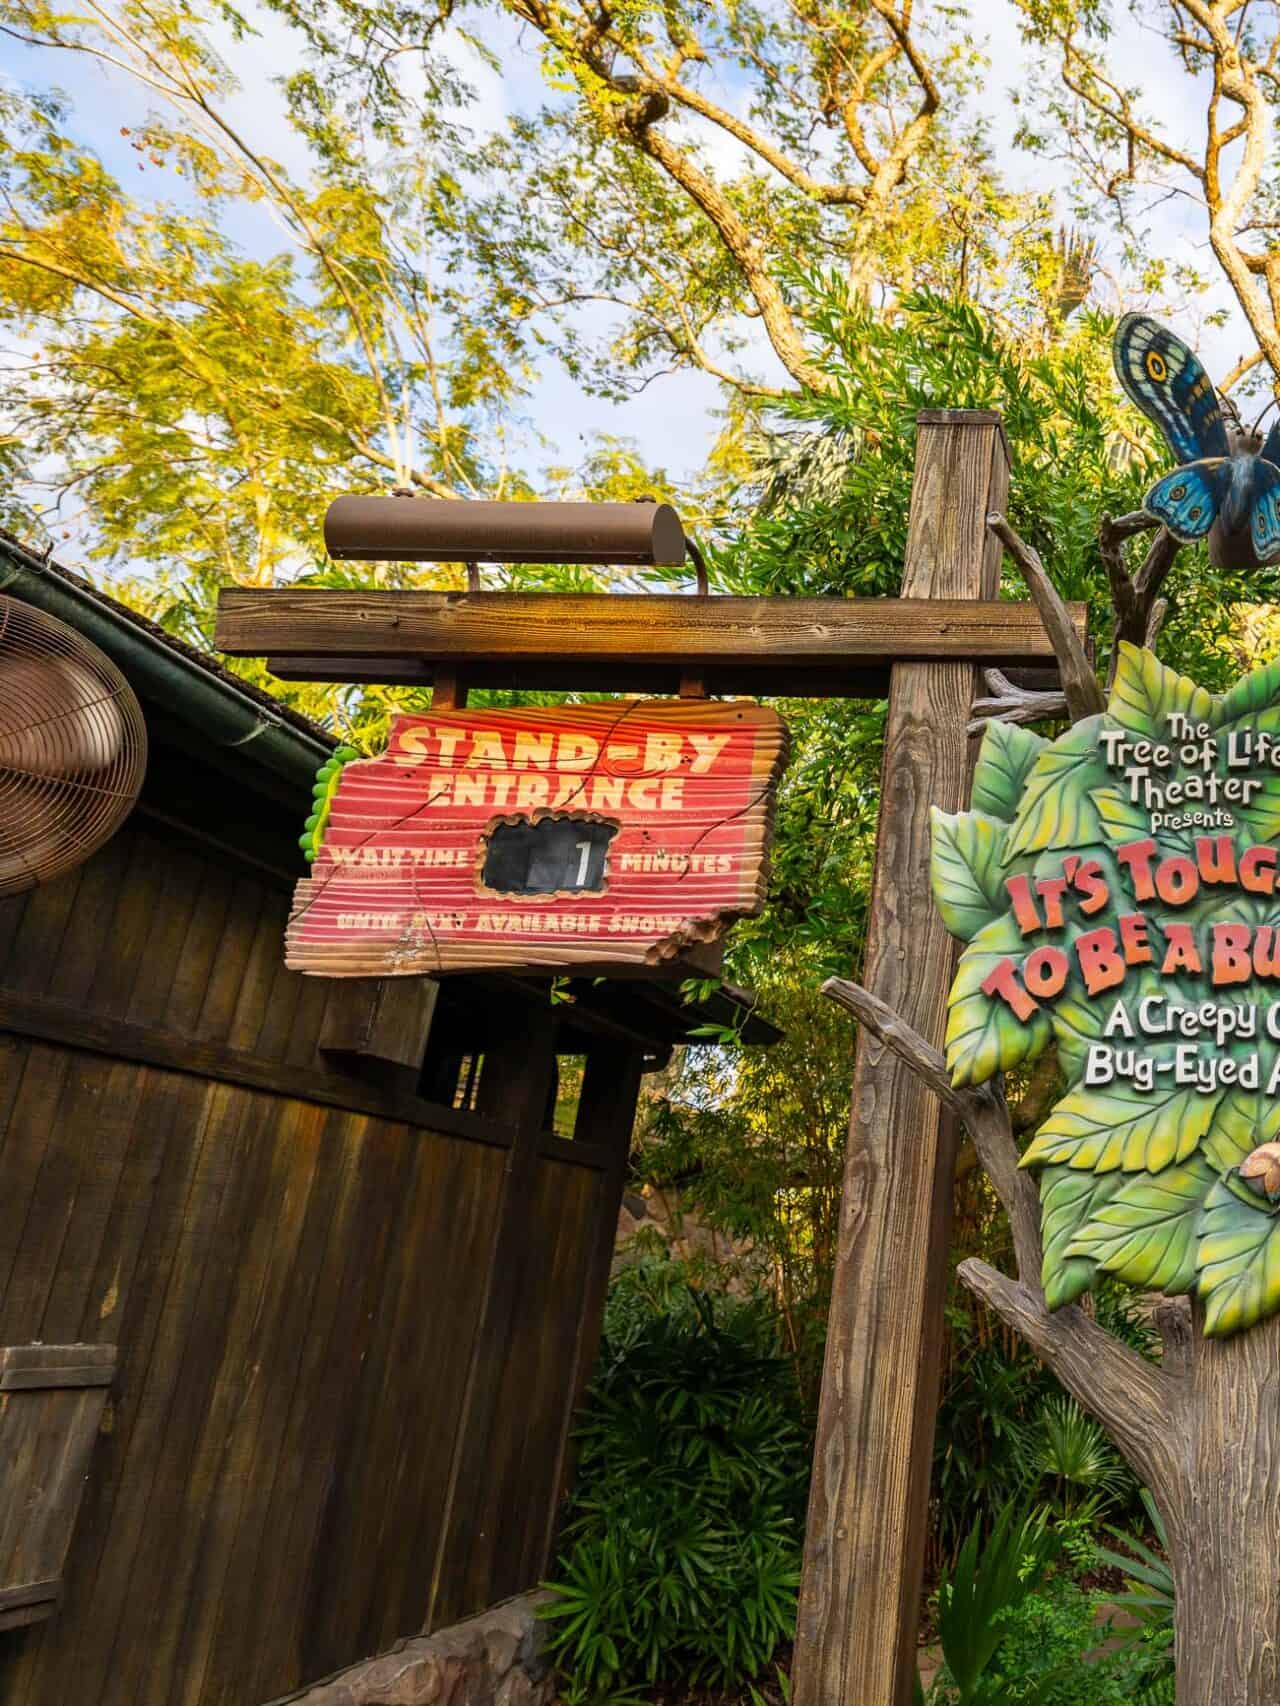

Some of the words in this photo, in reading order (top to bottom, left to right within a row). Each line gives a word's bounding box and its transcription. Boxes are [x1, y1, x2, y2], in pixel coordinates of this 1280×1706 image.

[1166, 712, 1209, 741] The
[393, 727, 731, 773] STAND-BY
[1100, 730, 1169, 767] Tree
[1179, 738, 1217, 771] of
[428, 774, 685, 809] ENTRANCE
[1124, 767, 1263, 809] Theater
[1151, 808, 1233, 833] presents
[328, 848, 407, 867] WAIT
[411, 849, 469, 867] TIME
[575, 841, 592, 886] 1
[621, 853, 733, 873] MINUTES
[1007, 856, 1111, 936] IT'S
[475, 914, 601, 933] AVAILABLE
[980, 946, 1069, 1022] TO
[1075, 912, 1152, 995] BE
[1161, 923, 1201, 975] A
[1104, 1001, 1134, 1037] A
[1139, 997, 1256, 1046] Creepy
[1085, 1044, 1259, 1093] Bug-Eyed
